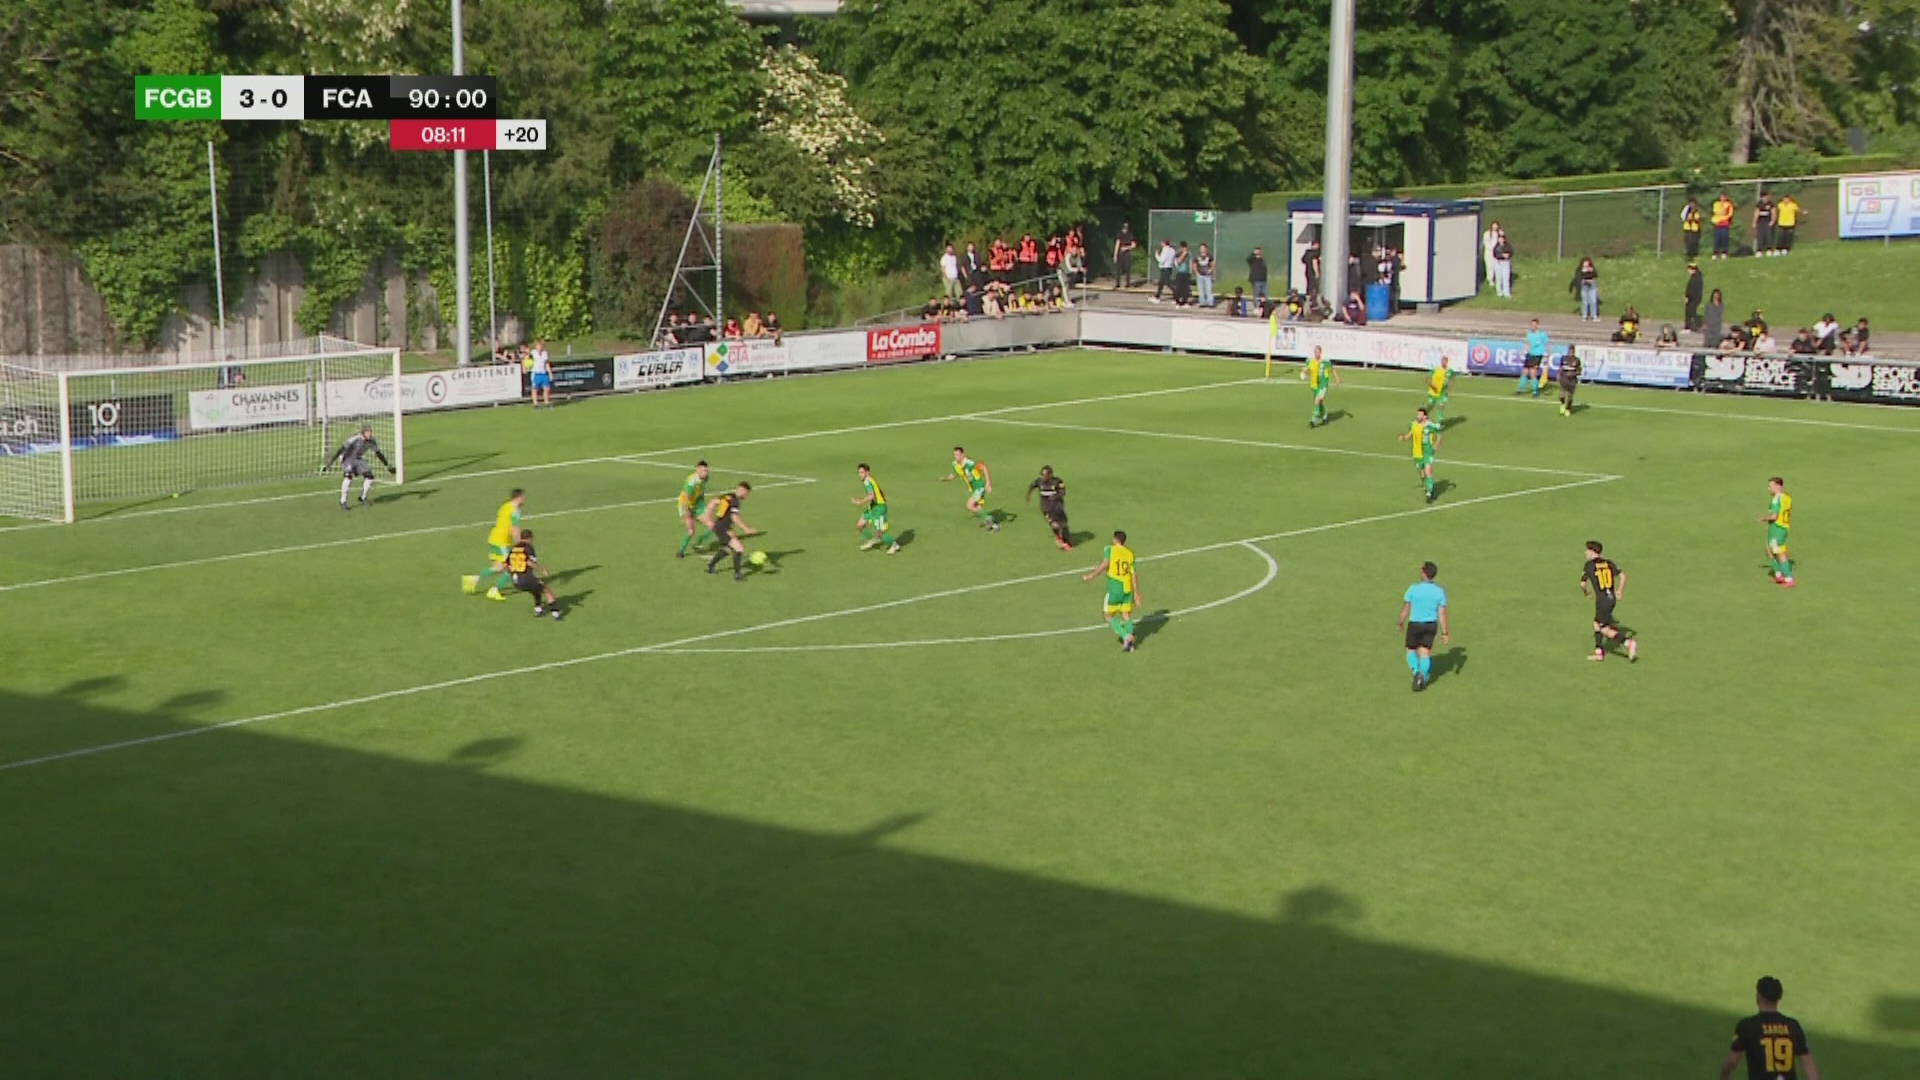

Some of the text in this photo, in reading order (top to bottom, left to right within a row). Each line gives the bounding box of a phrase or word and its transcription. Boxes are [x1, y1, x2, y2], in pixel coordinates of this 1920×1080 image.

[889, 328, 936, 349] Combe
[451, 366, 516, 381] CHRISTENER
[1746, 358, 1787, 373] SPORT
[1873, 365, 1917, 380] SPORT
[1872, 377, 1920, 393] SERVIC
[232, 389, 299, 406] CHAVANNES
[1115, 559, 1130, 576] 19
[1595, 568, 1613, 590] 10
[1760, 1036, 1794, 1072] 19
